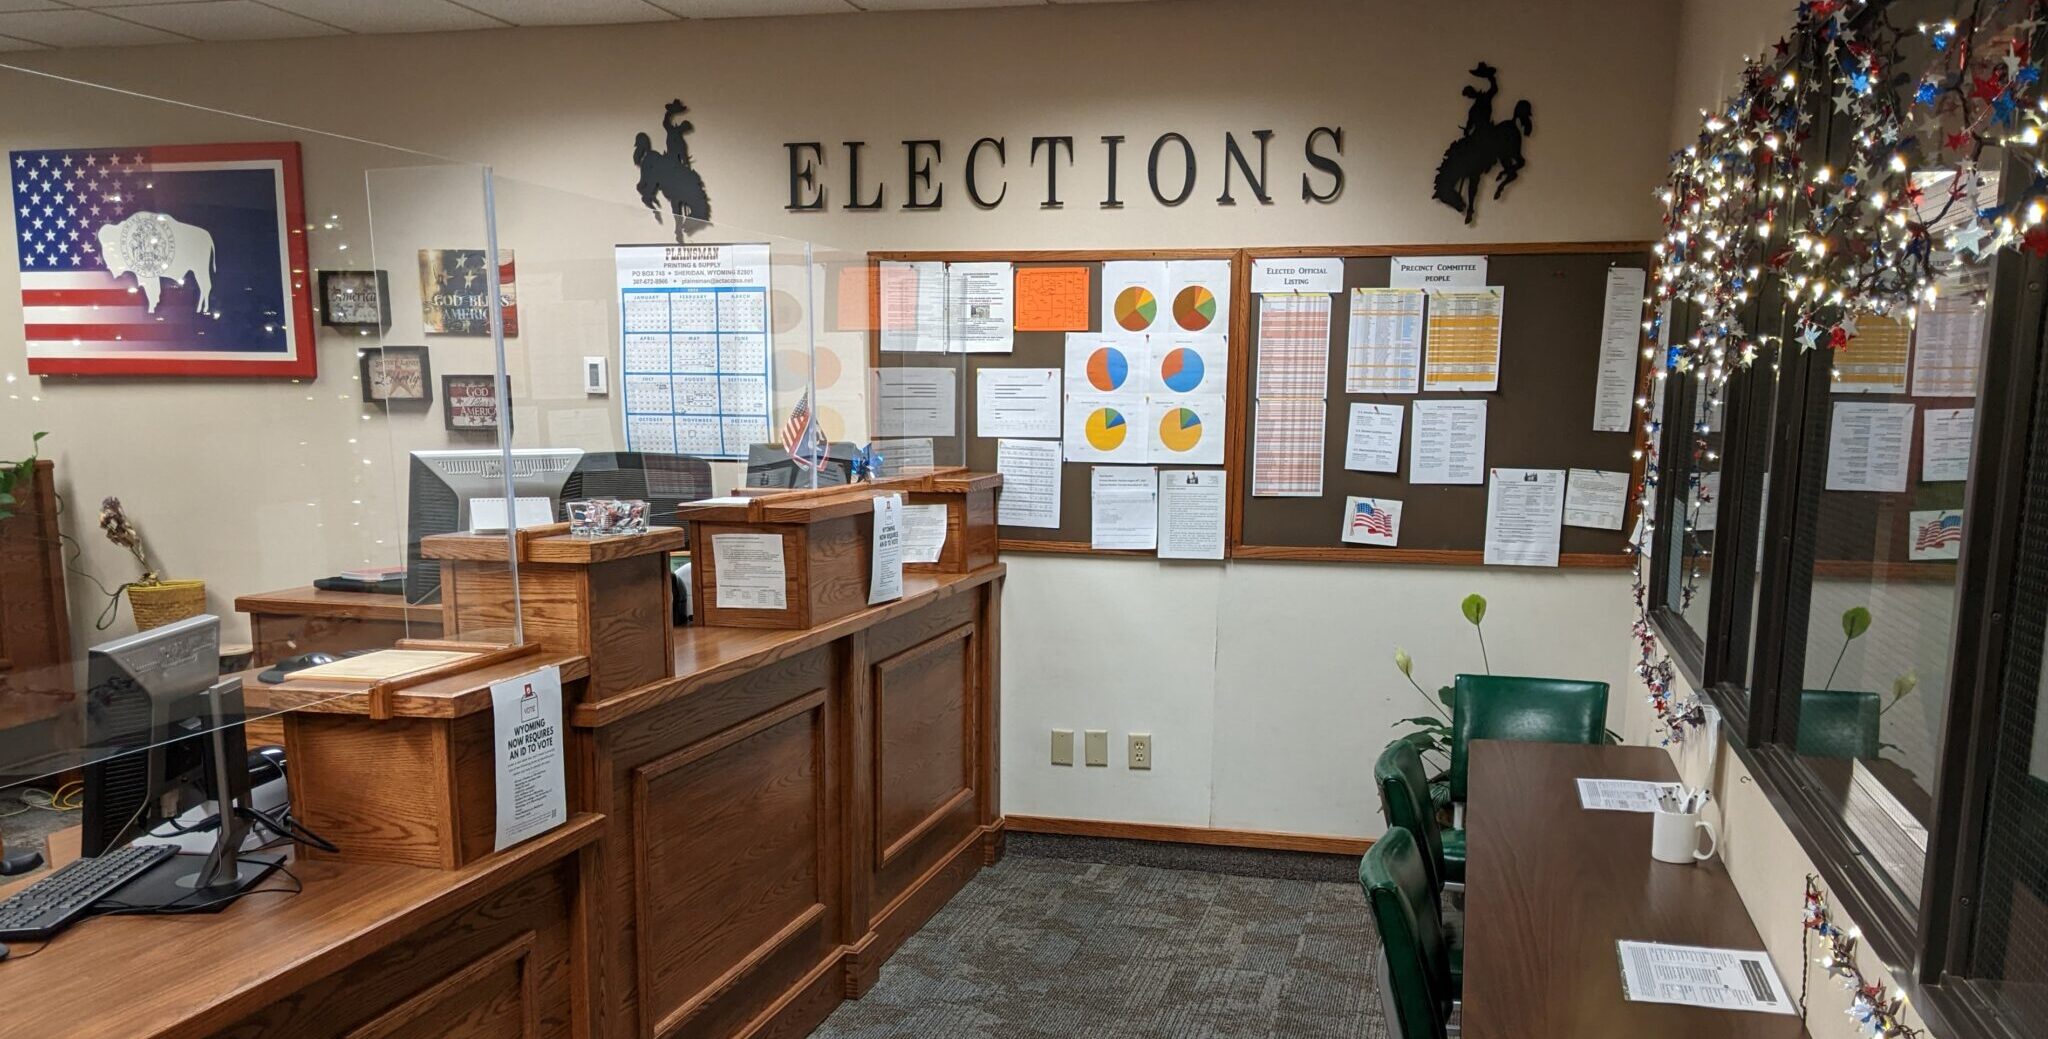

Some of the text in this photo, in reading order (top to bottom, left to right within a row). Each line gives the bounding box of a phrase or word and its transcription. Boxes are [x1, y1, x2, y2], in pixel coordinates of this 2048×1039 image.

[783, 126, 1345, 211] ELECTIONS
[665, 247, 720, 261] PLAINSMAN
[432, 294, 463, 306] GOD
[466, 386, 489, 397] GOD
[524, 705, 536, 714] VOTE
[514, 719, 545, 736] WYOMING
[508, 726, 554, 751] NOW REQUIRES
[510, 738, 553, 760] AN ID TO VOTE
